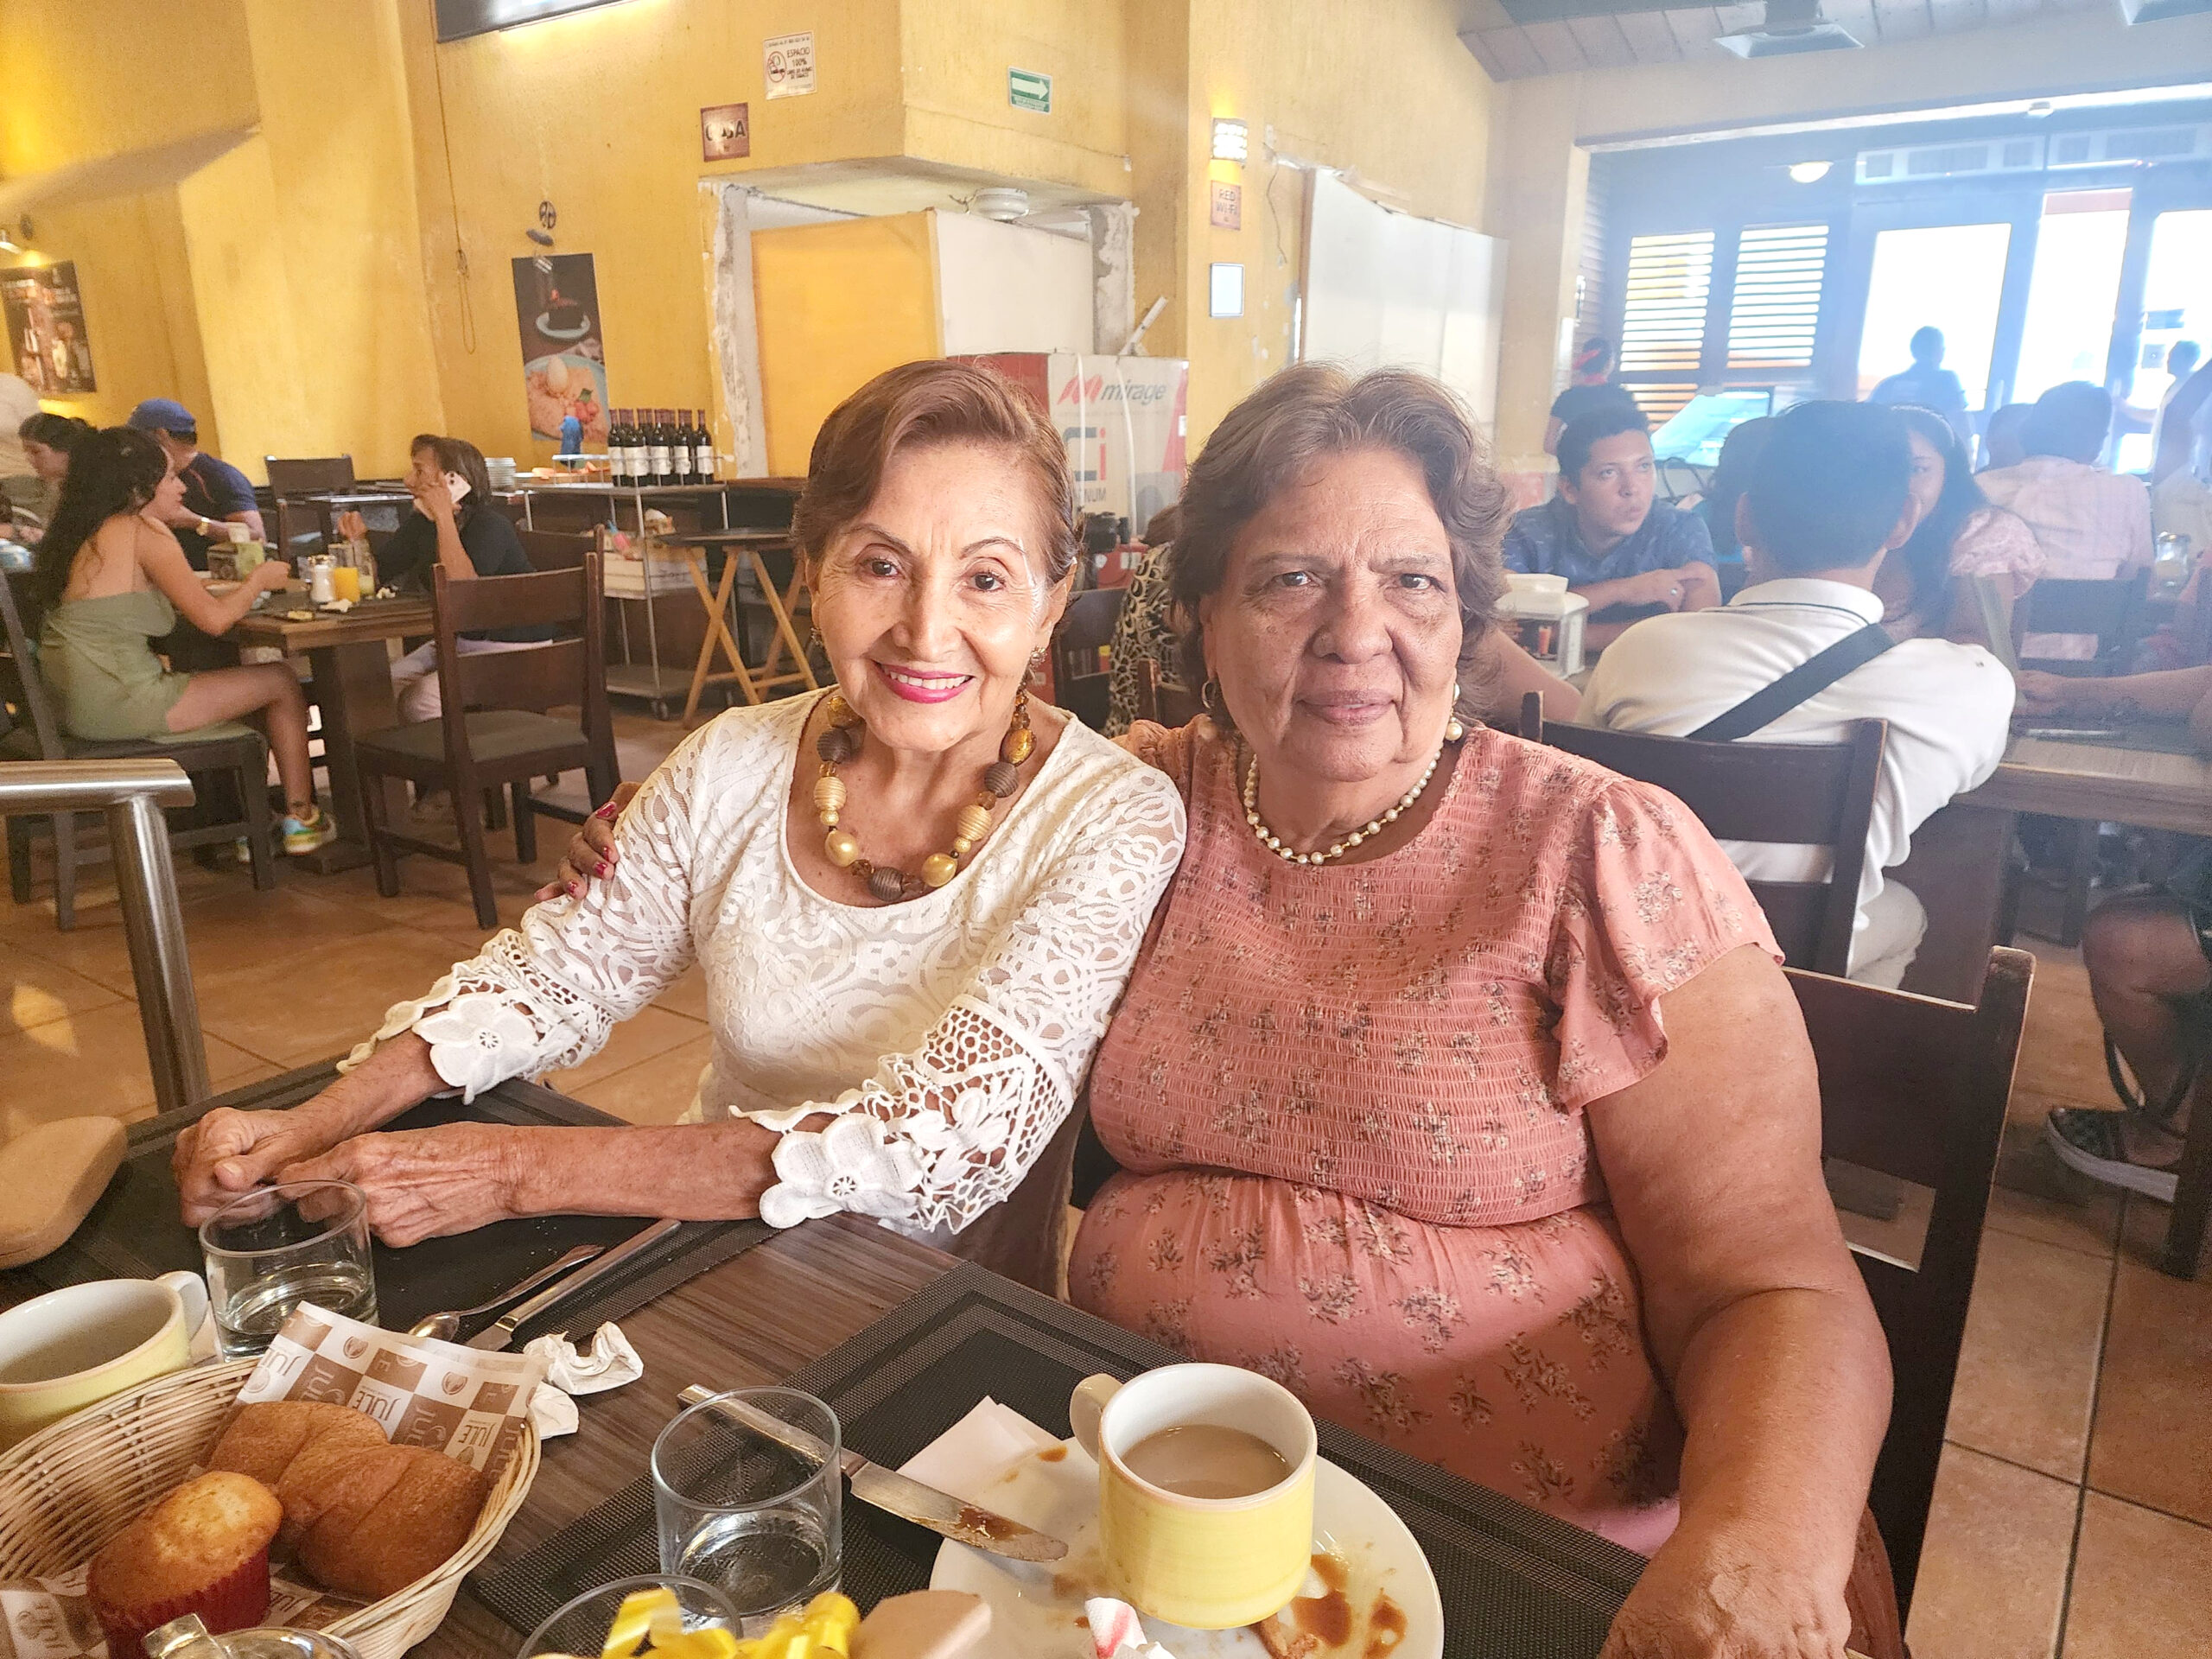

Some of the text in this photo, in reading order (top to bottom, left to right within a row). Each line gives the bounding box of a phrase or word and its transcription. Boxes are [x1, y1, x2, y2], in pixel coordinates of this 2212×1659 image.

[787, 47, 810, 59] ESPACIO
[791, 57, 808, 67] 100%
[1101, 378, 1167, 406] mirage
[262, 1347, 302, 1377] JUL
[298, 1363, 335, 1402] JUL
[352, 1390, 402, 1422] JULE
[404, 1403, 437, 1445] JUL
[458, 1421, 498, 1448] JULE
